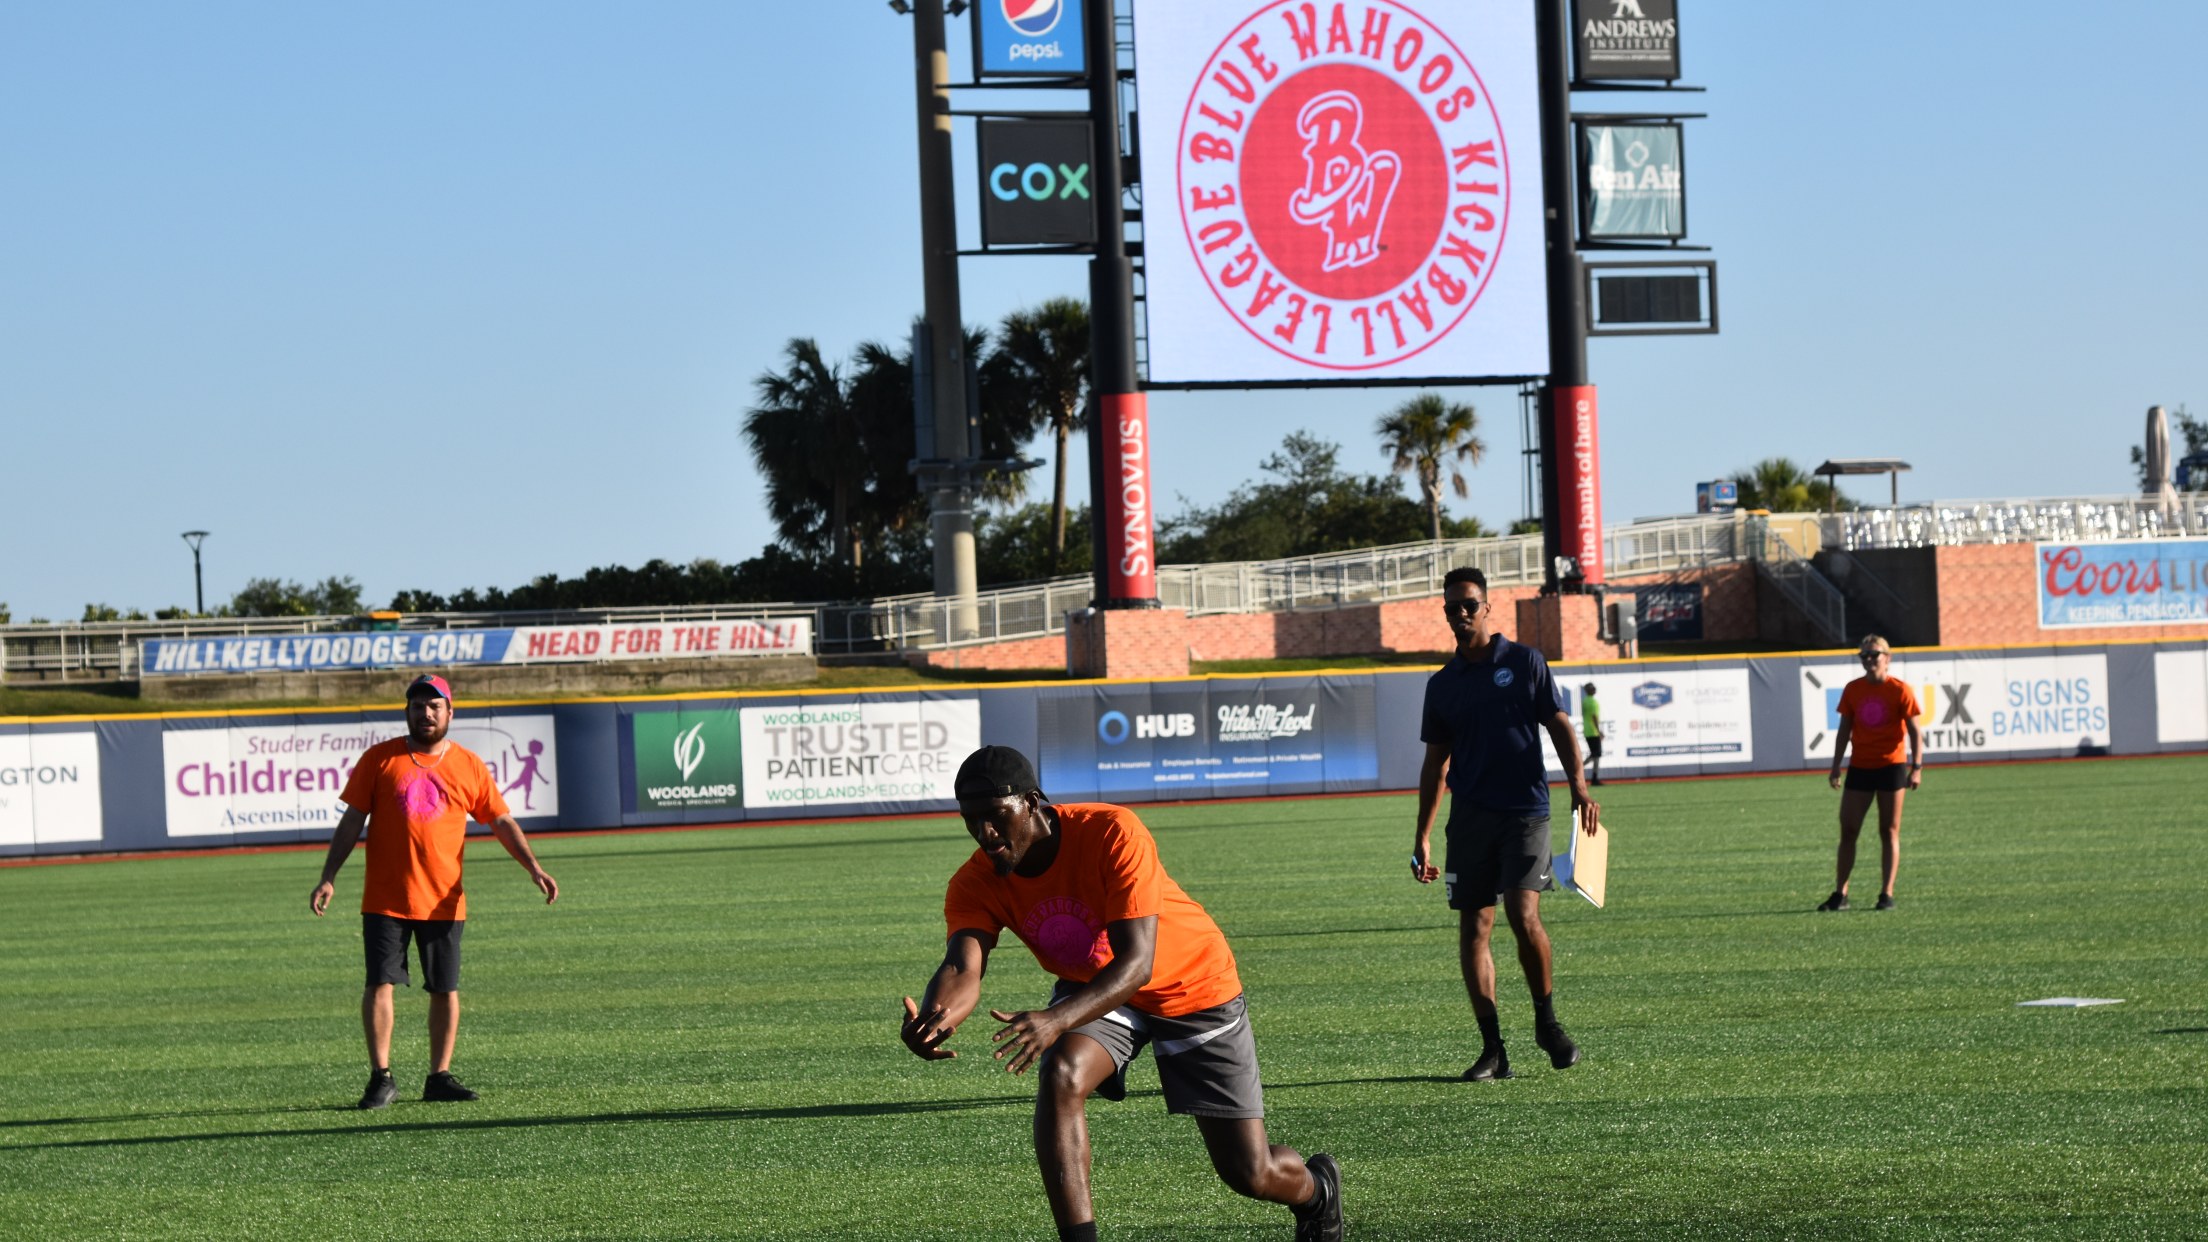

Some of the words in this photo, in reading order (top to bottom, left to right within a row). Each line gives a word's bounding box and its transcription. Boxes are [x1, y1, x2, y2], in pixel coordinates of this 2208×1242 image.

[1583, 18, 1676, 39] ANDREWS
[1009, 41, 1059, 61] pepsi
[1589, 38, 1670, 49] INSTITUTE
[1281, 3, 1476, 123] WAHOOS
[1189, 33, 1279, 164] BLUE
[1639, 164, 1681, 190] Air
[1350, 139, 1499, 357] KICKBALL
[1190, 184, 1333, 355] LEAGUE
[1573, 400, 1593, 448] here
[1574, 449, 1593, 472] of
[1120, 418, 1149, 577] SYNOVUS
[1576, 475, 1596, 530] bank
[1581, 533, 1597, 567] the
[2043, 546, 2163, 597] Coors
[2127, 601, 2203, 620] PENSACOLA
[154, 632, 486, 672] HILLKELLYDODGE.COM
[527, 630, 600, 657] HEAD
[610, 627, 663, 654] FOR
[672, 625, 721, 652] THE
[730, 623, 798, 650] HILL!
[2008, 677, 2091, 708] SIGNS
[762, 711, 861, 726] WOODLANDS
[1135, 712, 1196, 739] HUB
[1992, 706, 2106, 736] BANNERS
[248, 735, 315, 755] Studer
[764, 720, 949, 757] TRUSTED
[1922, 729, 1986, 748] NTING
[647, 784, 737, 800] WOODLANDS
[766, 782, 936, 802] WOODLANDSMED.COM
[220, 804, 328, 827] Ascension
